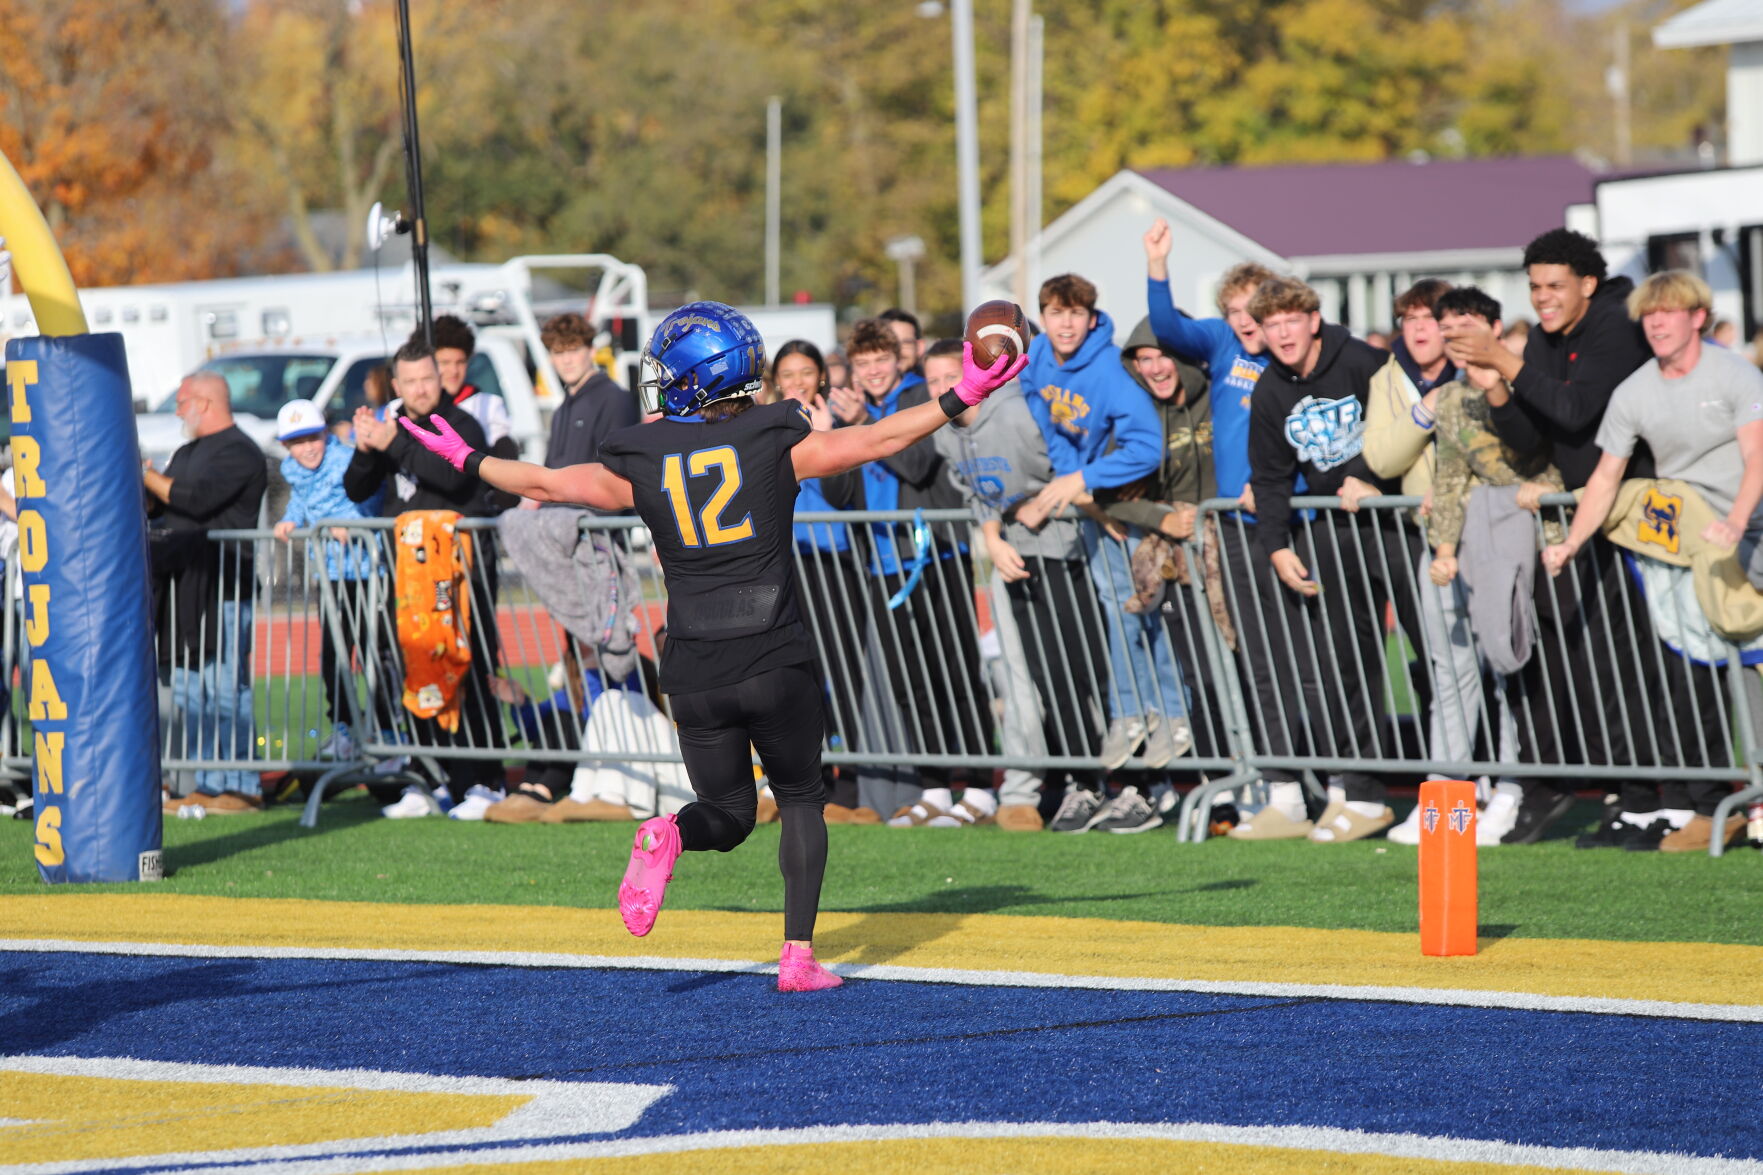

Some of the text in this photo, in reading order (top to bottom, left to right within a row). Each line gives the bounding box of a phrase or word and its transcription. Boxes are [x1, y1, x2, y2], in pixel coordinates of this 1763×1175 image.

[660, 313, 721, 337] Trojans
[661, 445, 756, 550] 12
[7, 359, 68, 866] TROJANS
